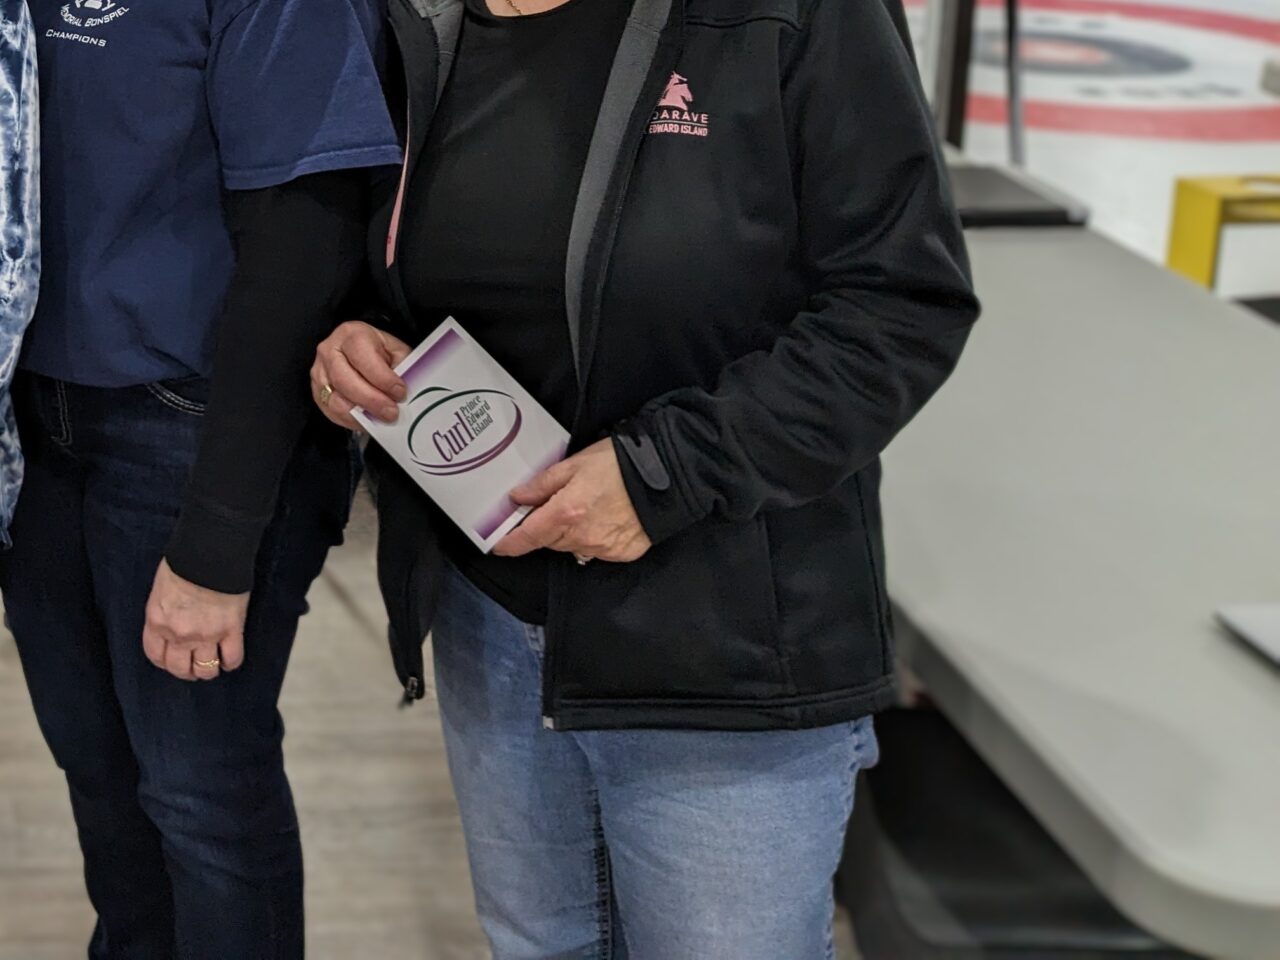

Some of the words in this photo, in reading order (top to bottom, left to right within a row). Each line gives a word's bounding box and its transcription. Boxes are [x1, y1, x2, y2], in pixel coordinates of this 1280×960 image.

[84, 6, 130, 27] BONSPIEL
[648, 123, 680, 134] EDWARD
[680, 124, 709, 137] ISLAND
[459, 395, 482, 418] Prince
[465, 400, 491, 427] Edward
[471, 413, 494, 437] Island
[432, 411, 476, 463] Curl
